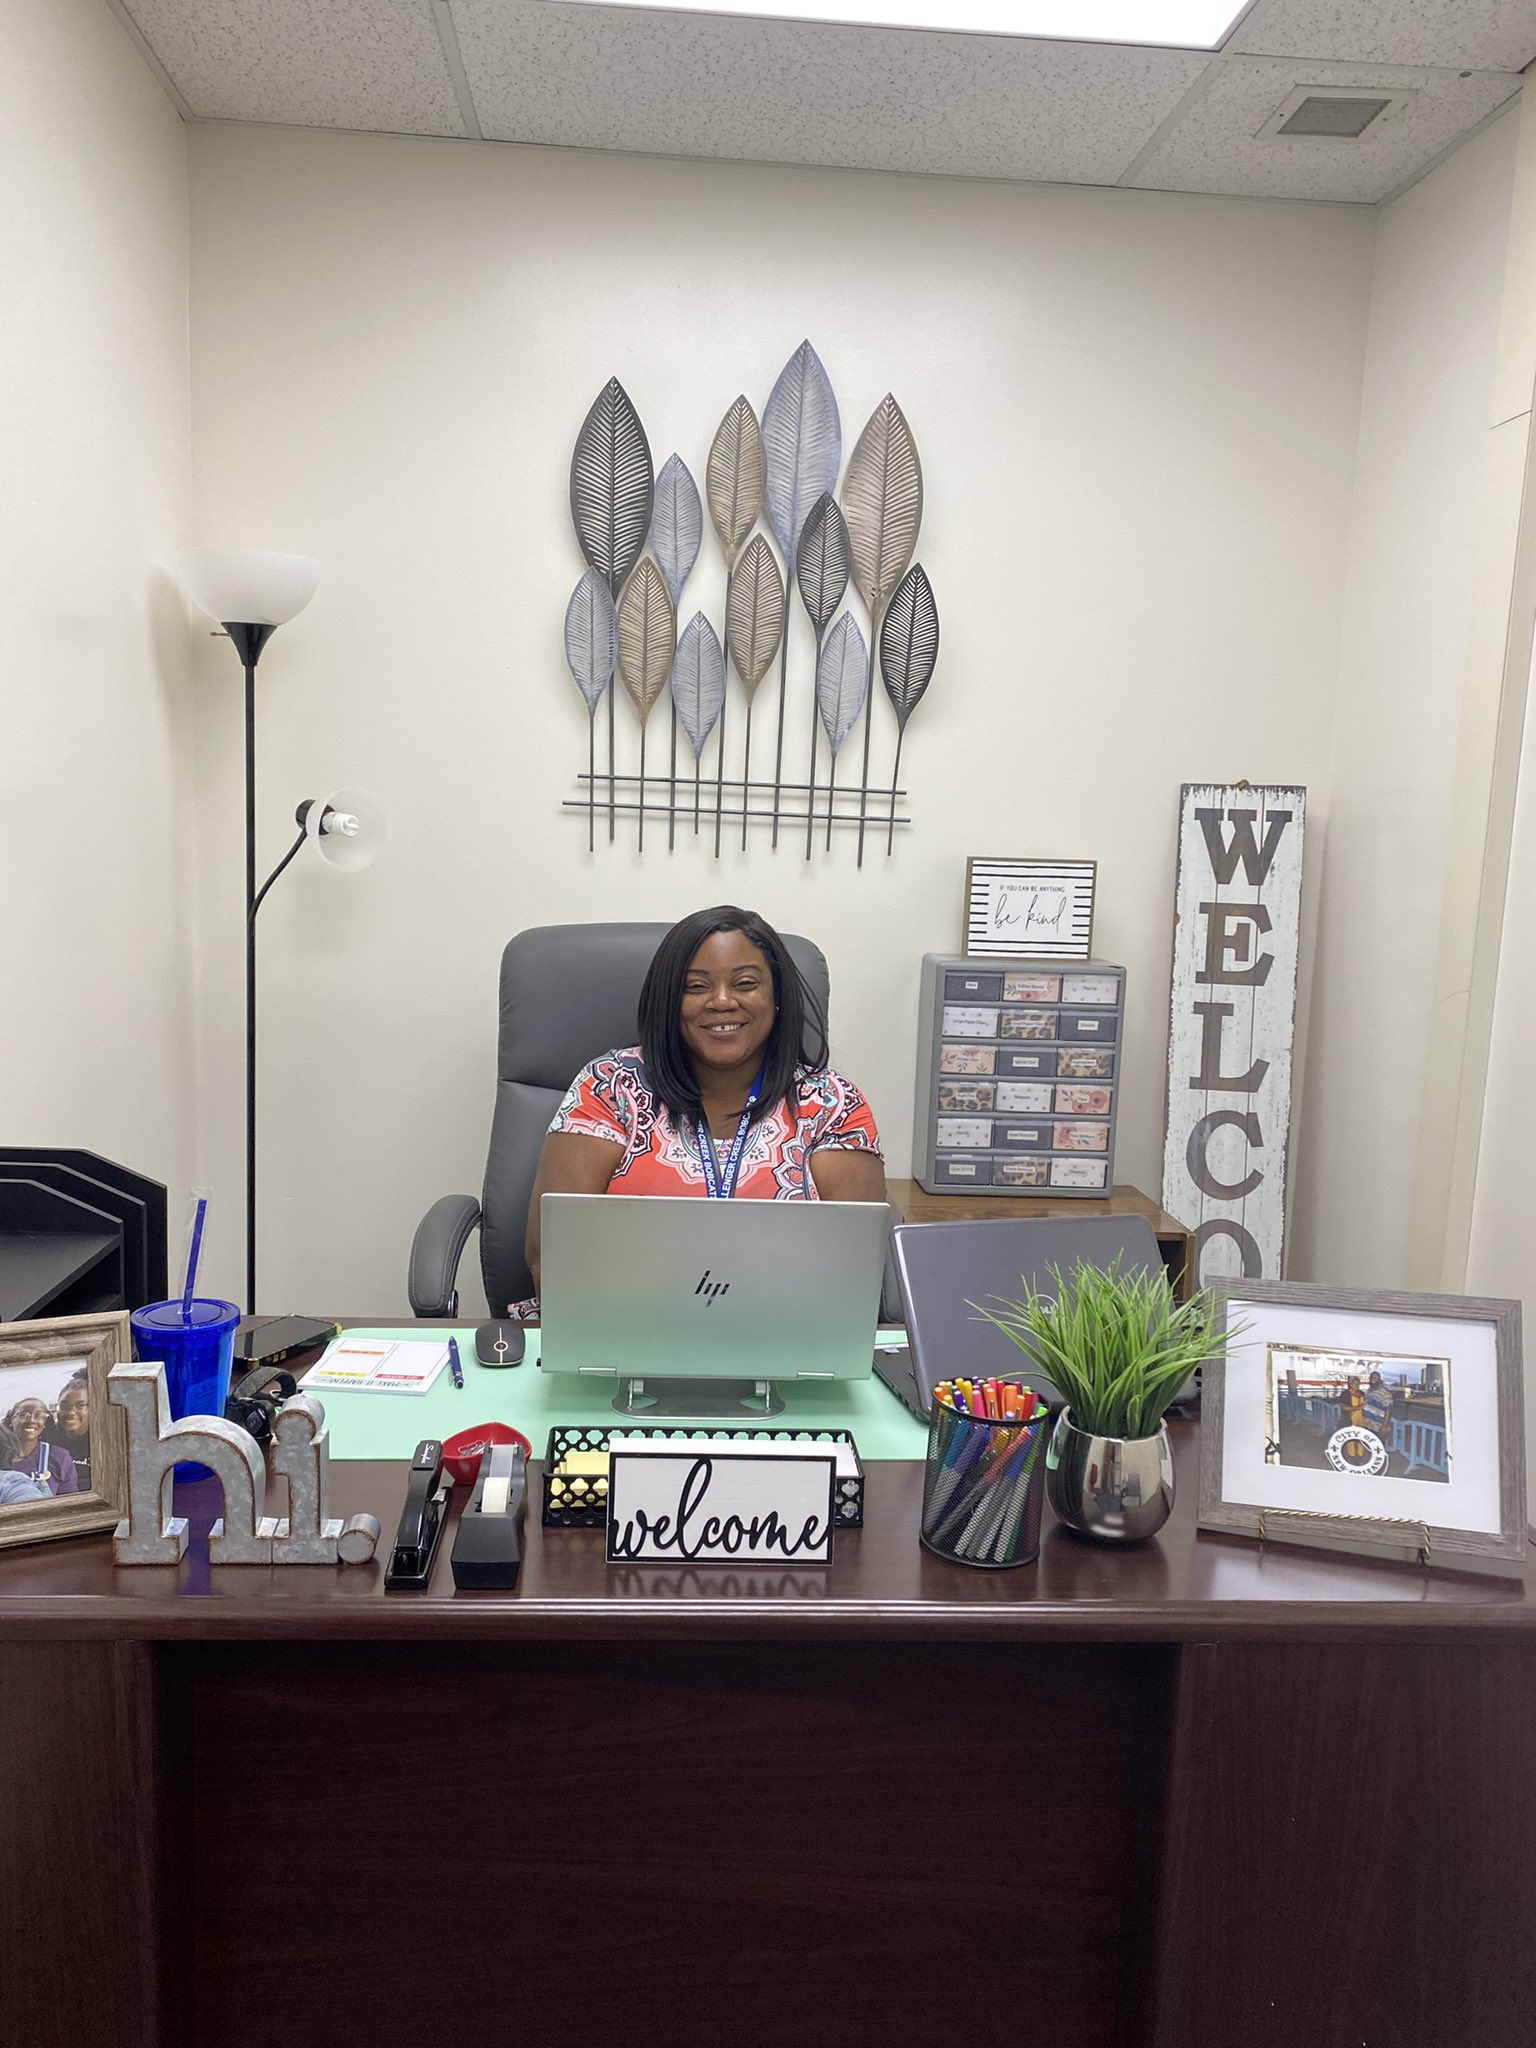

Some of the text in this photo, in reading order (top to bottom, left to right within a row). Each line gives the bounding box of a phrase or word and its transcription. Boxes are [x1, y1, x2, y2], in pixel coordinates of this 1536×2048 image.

[994, 893, 1067, 934] be kind
[698, 1133, 711, 1161] CREEK
[730, 1136, 743, 1162] CREEK
[703, 1161, 717, 1198] BOBCAT
[694, 1270, 730, 1308] hp
[1335, 1430, 1361, 1443] CITY
[1331, 1454, 1347, 1471] NEW
[611, 1458, 834, 1558] welcome
